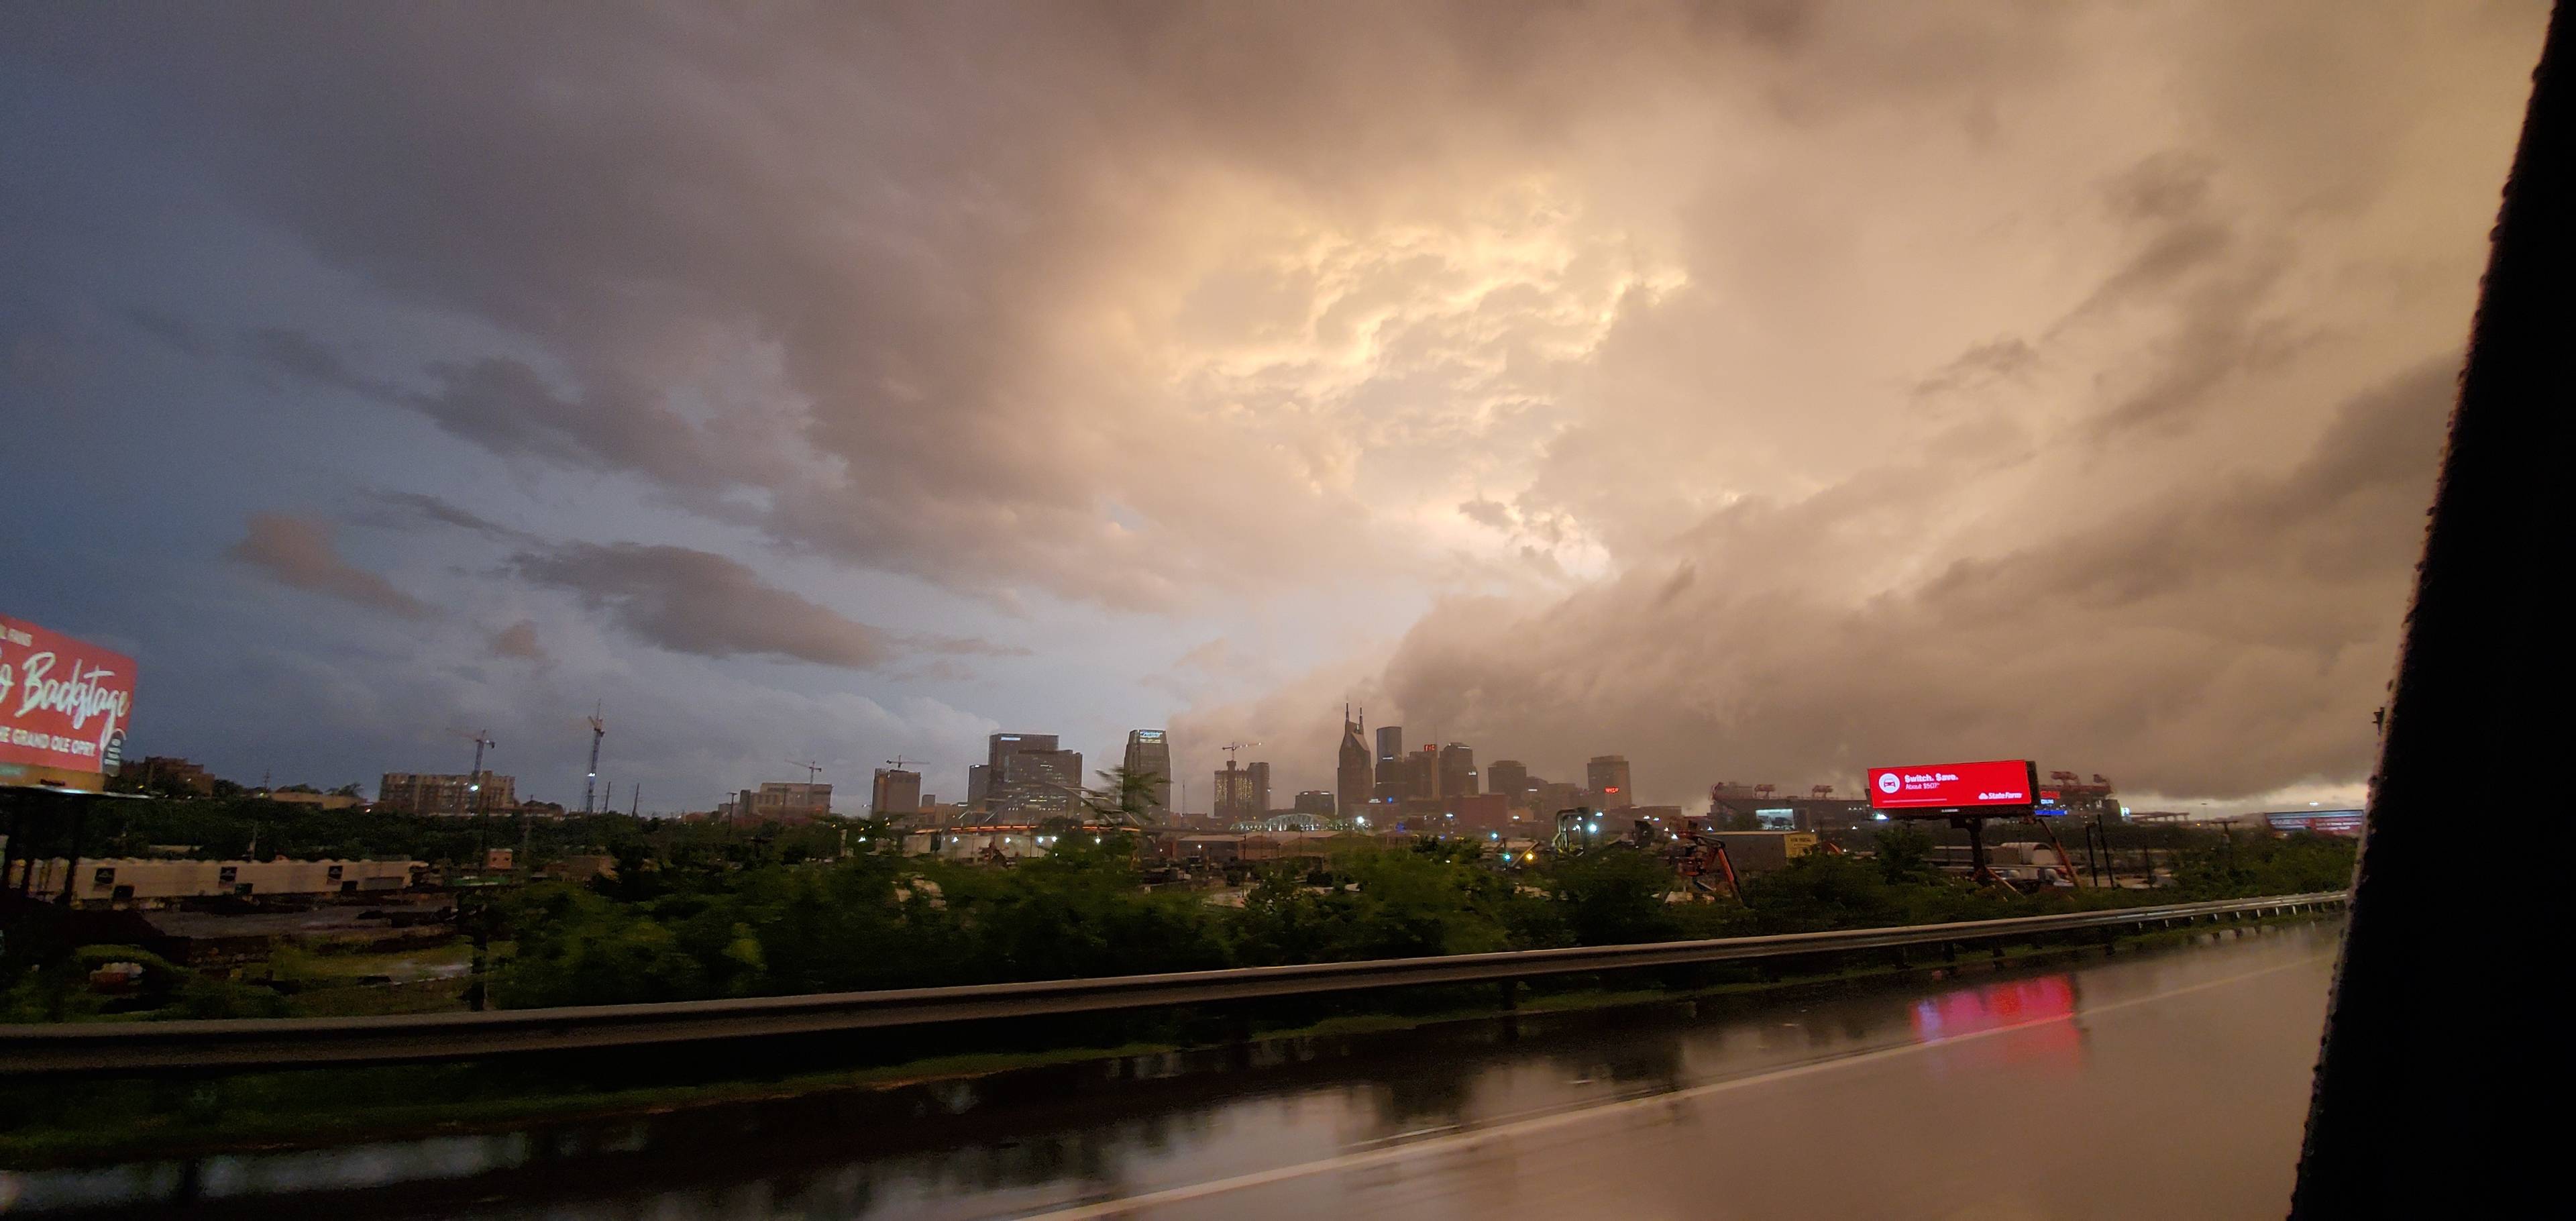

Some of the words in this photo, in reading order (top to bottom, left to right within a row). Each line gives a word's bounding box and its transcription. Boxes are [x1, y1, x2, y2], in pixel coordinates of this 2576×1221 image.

[14, 651, 129, 751] Backstage
[12, 729, 50, 749] GRAND
[50, 735, 71, 753] OLE
[1904, 774, 1935, 783] Switch.
[1935, 773, 1959, 781] Save.
